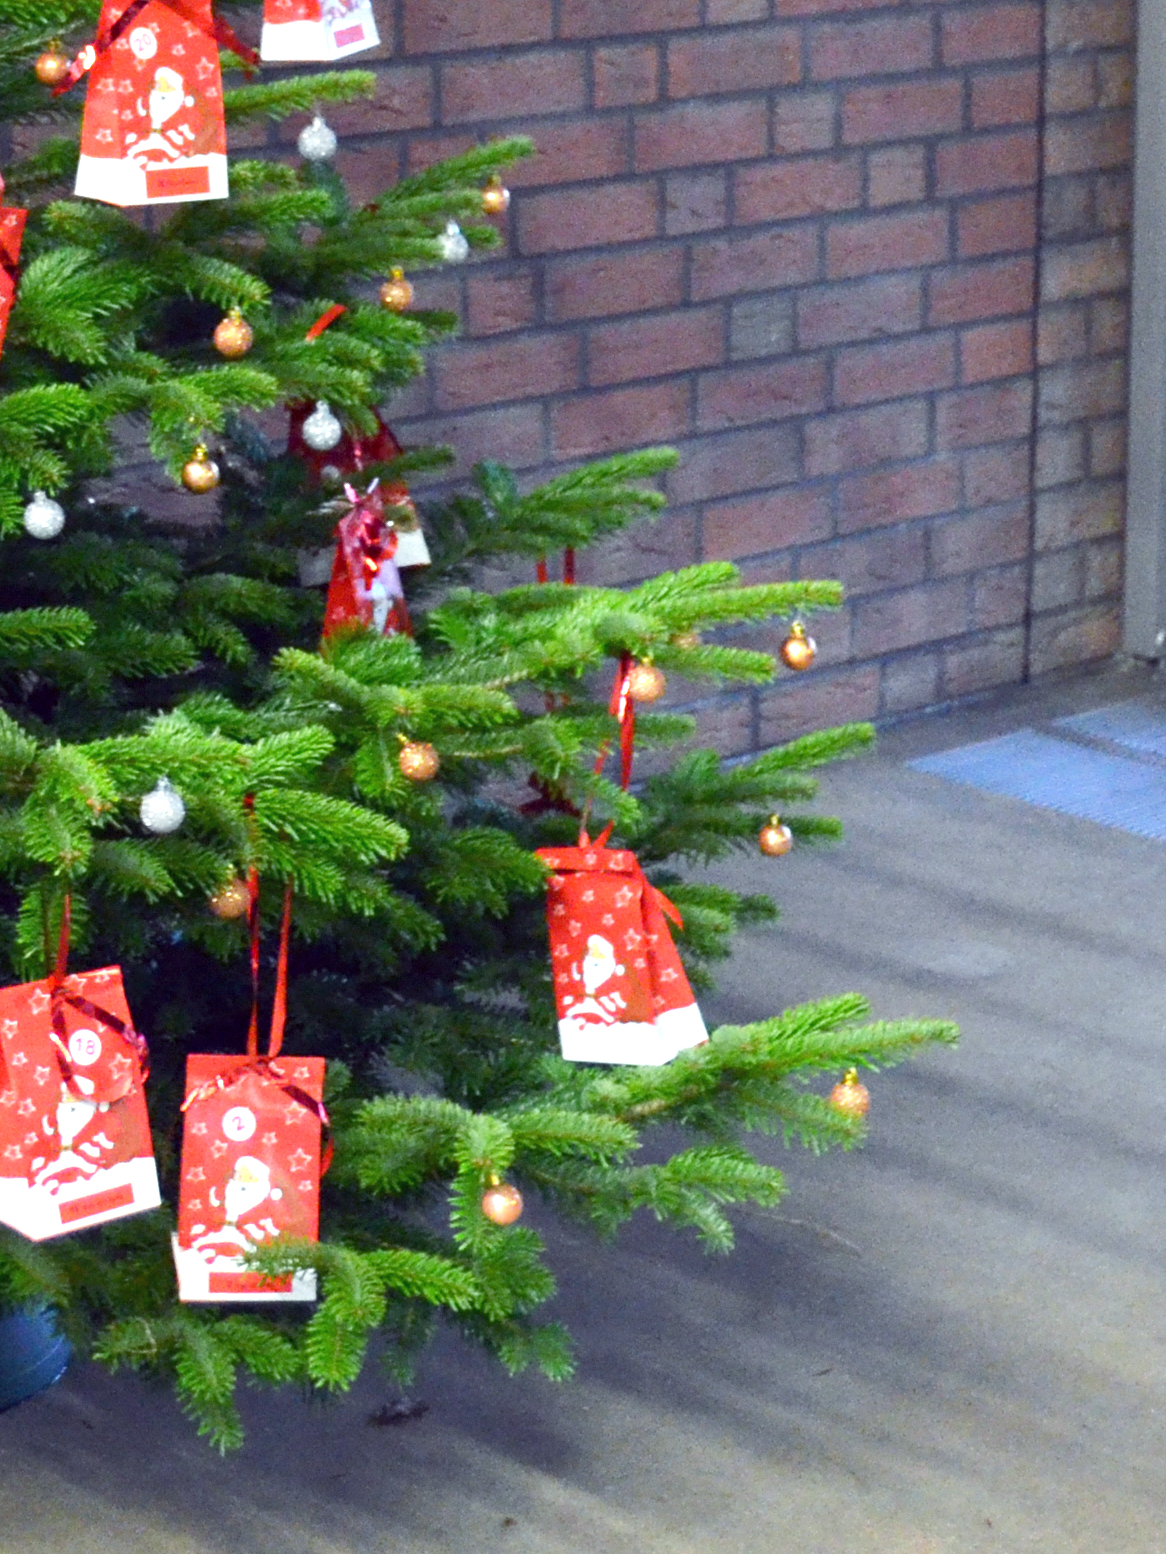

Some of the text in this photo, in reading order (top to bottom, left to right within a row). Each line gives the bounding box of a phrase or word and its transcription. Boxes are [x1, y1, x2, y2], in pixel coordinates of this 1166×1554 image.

[133, 32, 152, 52] 20
[75, 1037, 96, 1055] 18
[231, 1115, 245, 1132] 2
